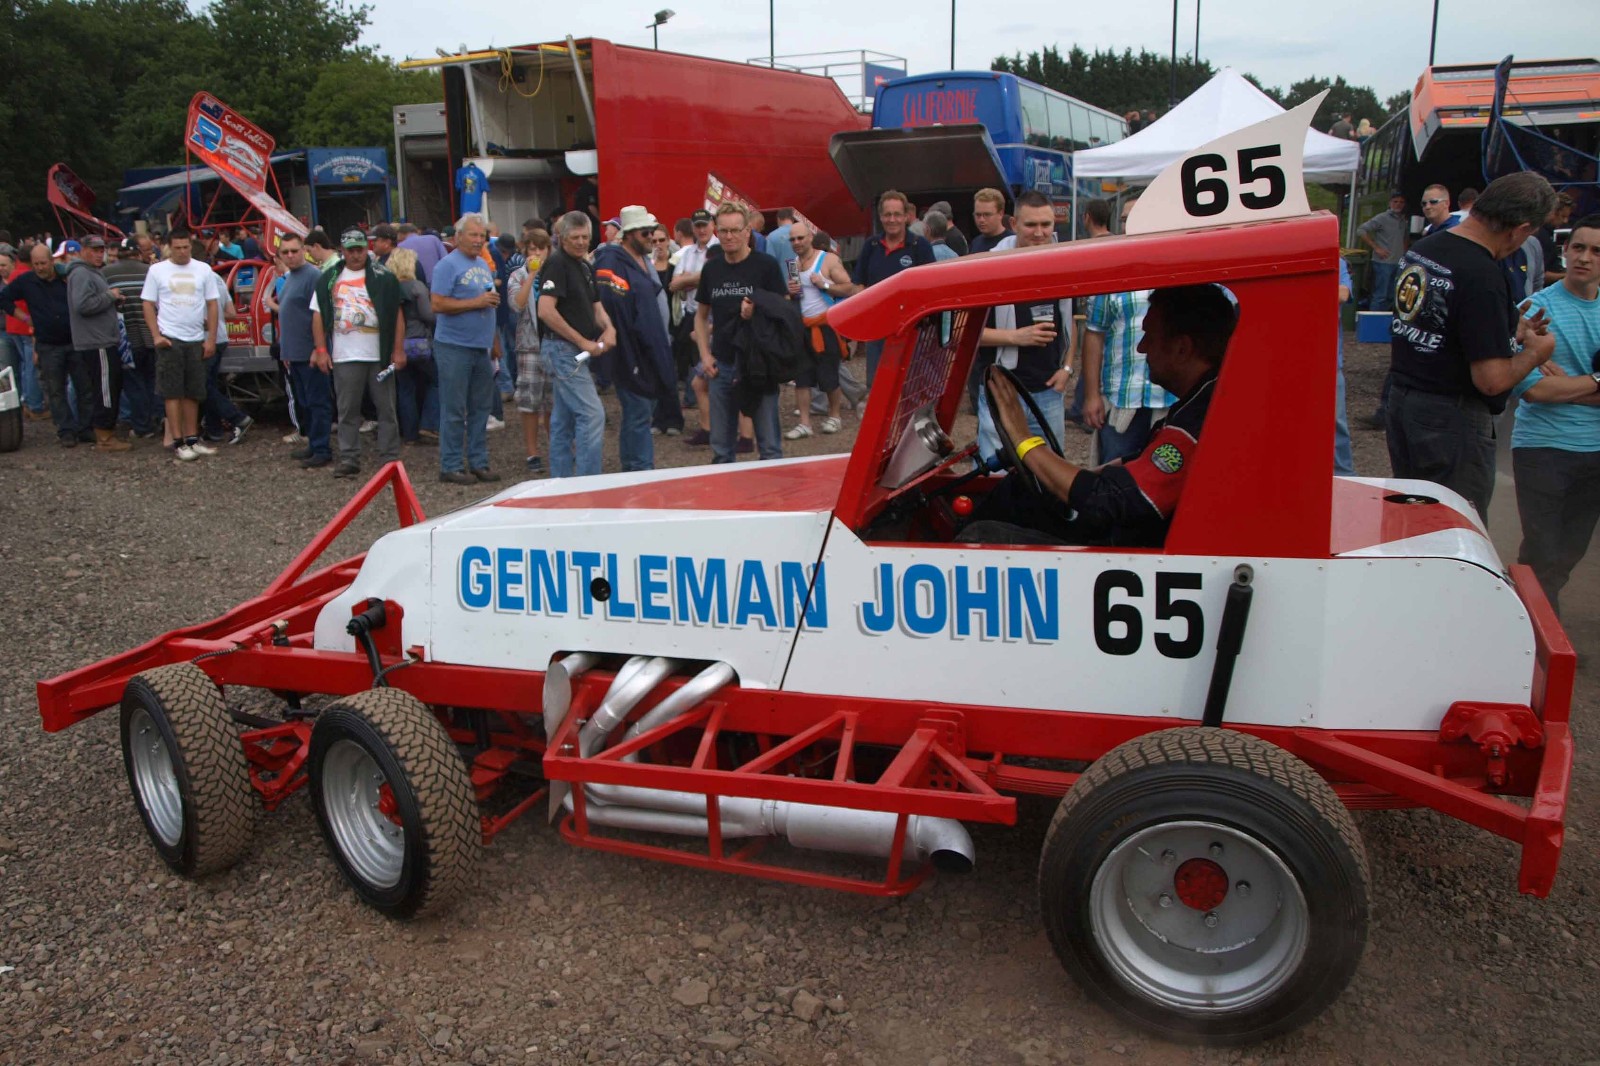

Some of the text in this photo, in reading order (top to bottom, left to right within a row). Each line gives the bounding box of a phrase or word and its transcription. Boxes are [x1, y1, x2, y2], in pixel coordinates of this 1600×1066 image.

[1180, 143, 1286, 217] 65
[711, 285, 754, 298] HANSEN
[457, 546, 1205, 659] GENTLEMAN JOHN 65
